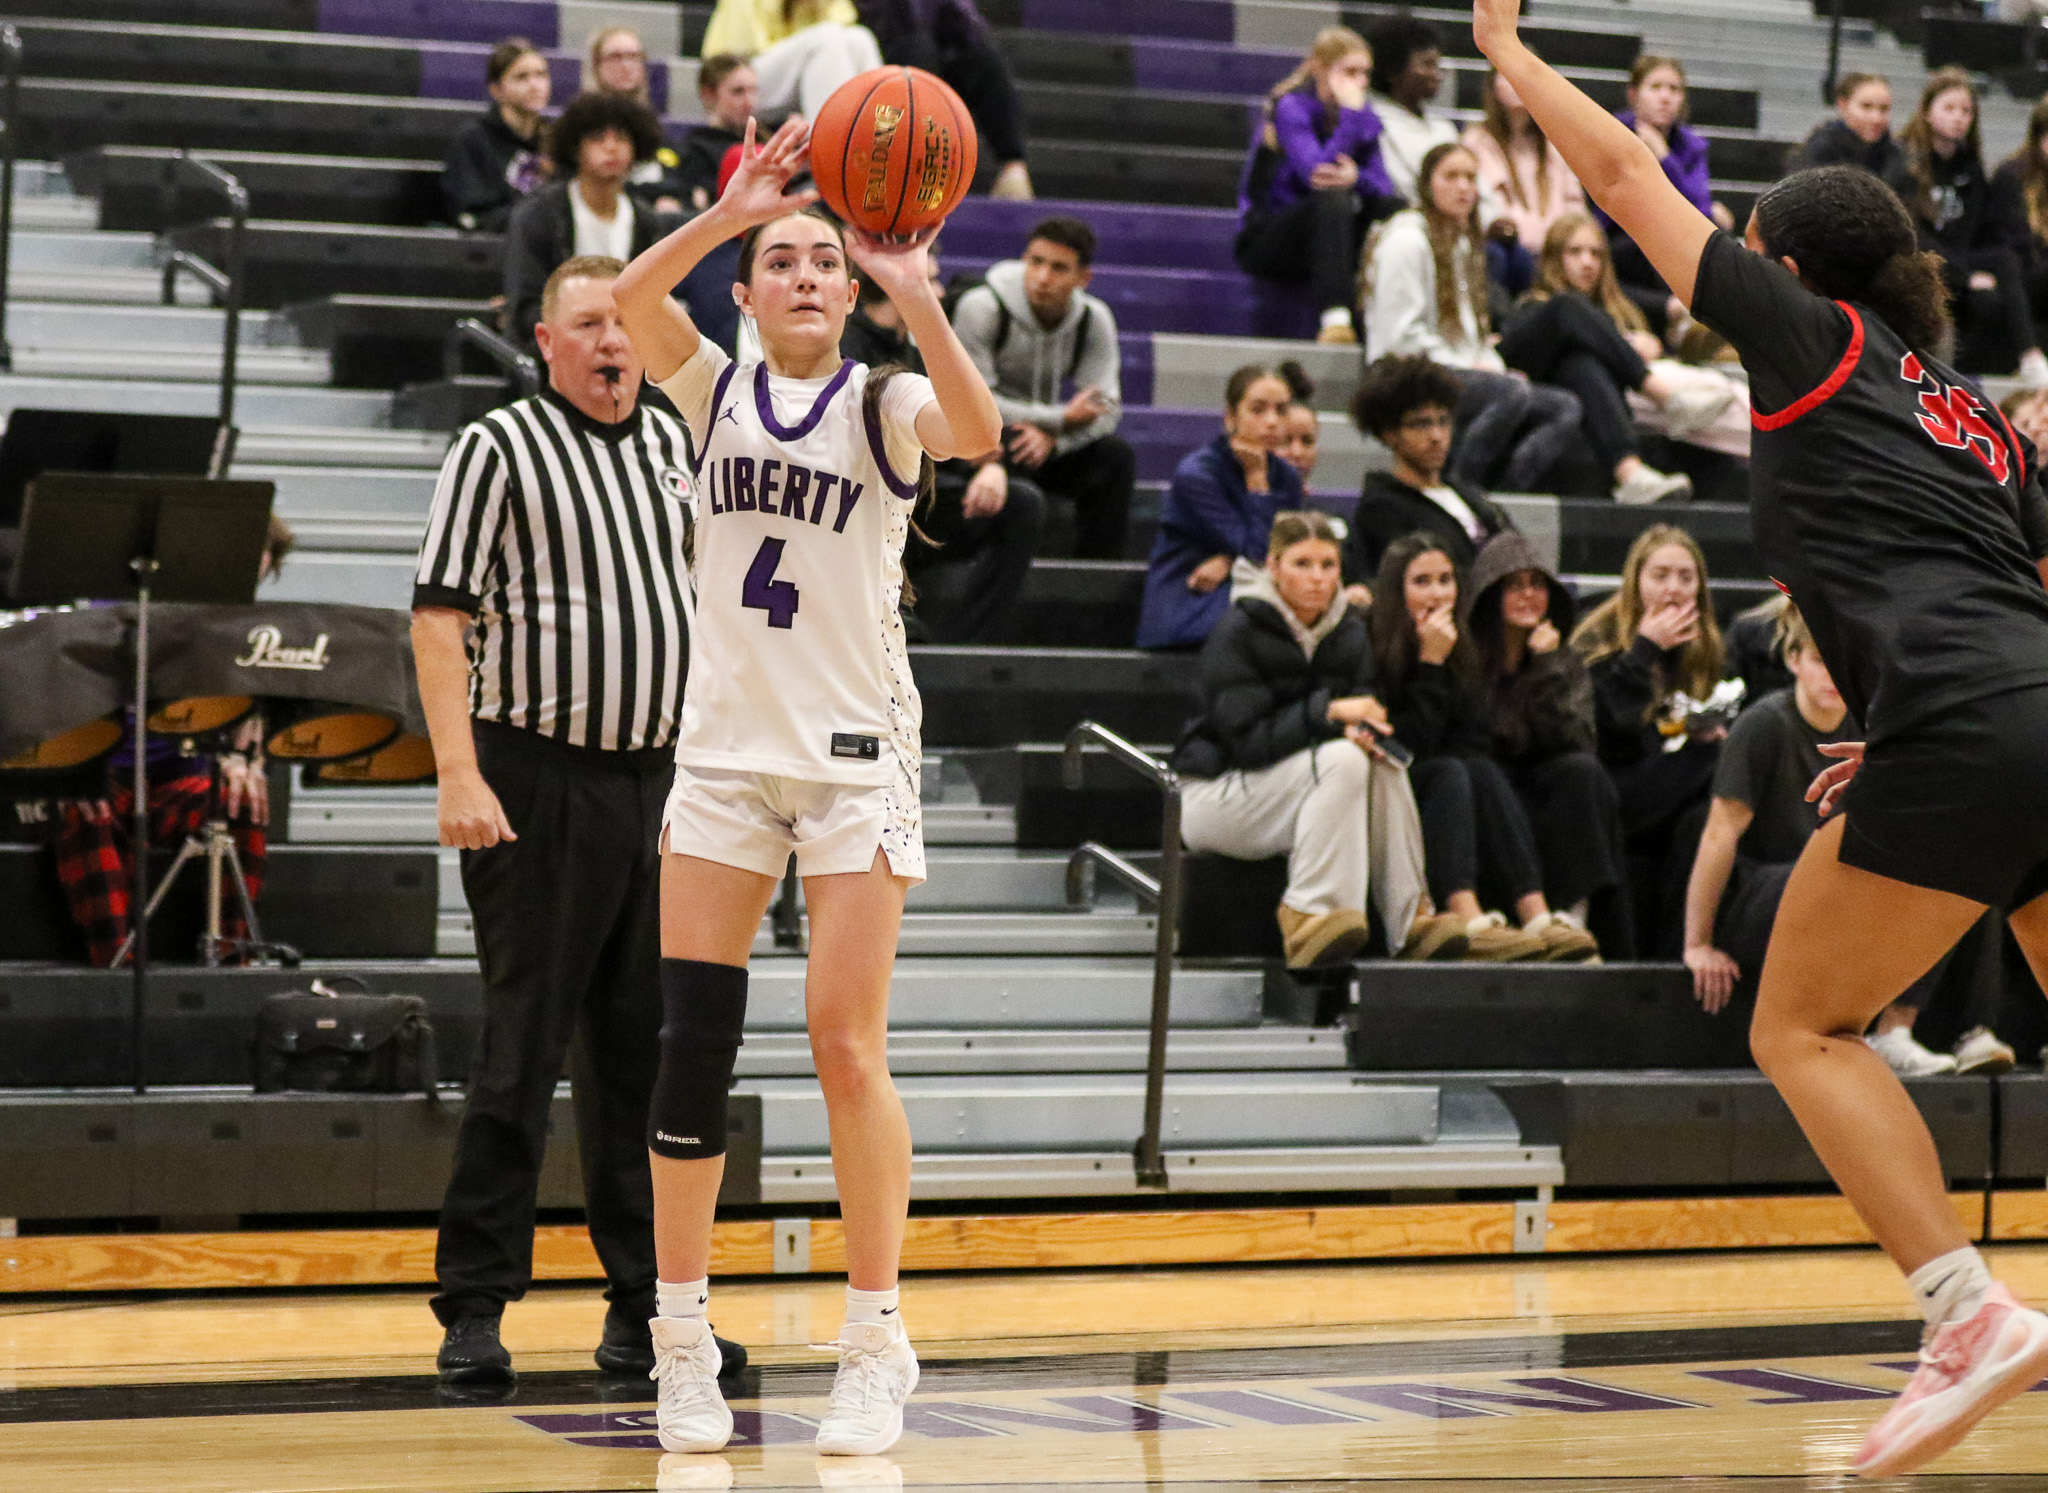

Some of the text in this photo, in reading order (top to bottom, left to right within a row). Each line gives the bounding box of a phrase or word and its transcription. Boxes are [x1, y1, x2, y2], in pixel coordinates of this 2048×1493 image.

[863, 103, 906, 214] SPALDING
[910, 116, 940, 215] LEGACY
[1899, 350, 2010, 487] 35
[709, 457, 865, 535] LIBERTY
[741, 535, 800, 630] 4
[235, 624, 330, 671] Pearl
[866, 742, 873, 753] S
